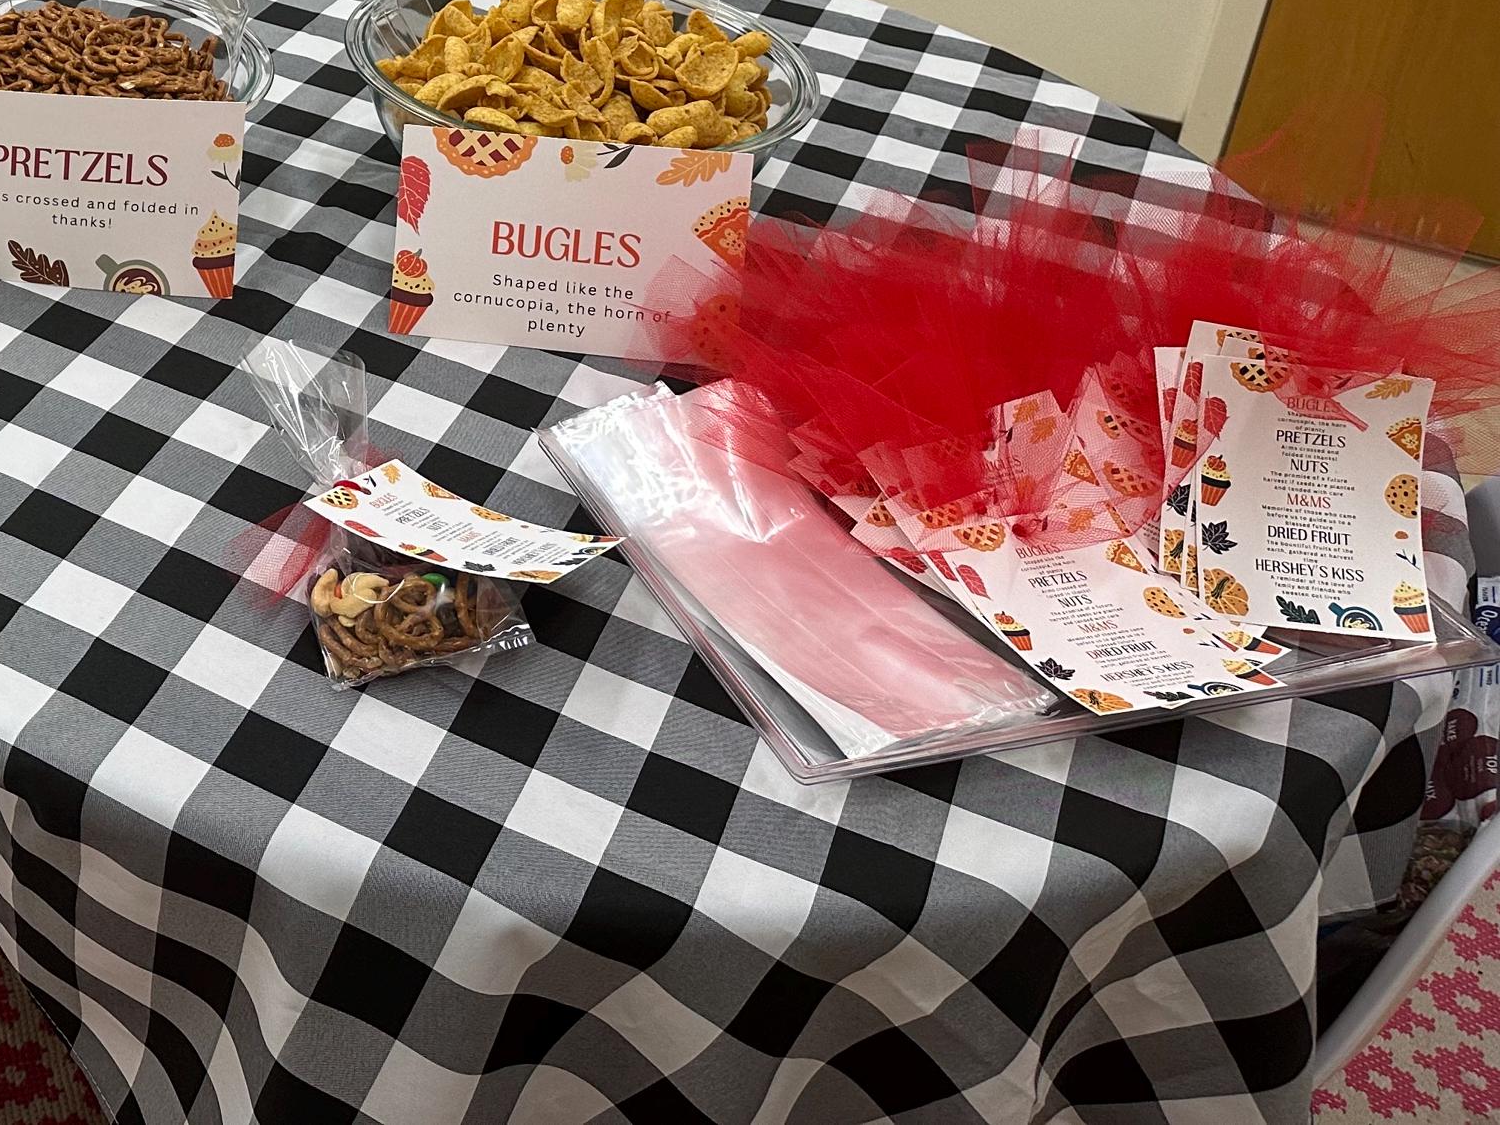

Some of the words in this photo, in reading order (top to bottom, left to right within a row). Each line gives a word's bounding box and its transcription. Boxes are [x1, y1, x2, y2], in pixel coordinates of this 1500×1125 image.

[16, 191, 80, 209] crossed
[87, 198, 117, 211] and
[123, 200, 178, 215] folded
[184, 203, 199, 215] in
[51, 213, 113, 229] thanks!
[491, 220, 642, 269] BUGLES
[492, 273, 558, 294] Shaped
[565, 280, 598, 297] like
[604, 285, 634, 300] the
[452, 290, 560, 315] cornucopia,
[568, 301, 596, 317] the
[604, 305, 645, 322] horn
[652, 311, 672, 324] of
[527, 317, 586, 338] plenty
[1276, 429, 1347, 448] PRETZELS
[1290, 459, 1329, 474] NUTS
[1286, 494, 1332, 509] M&MS
[1267, 525, 1308, 542] DRIED
[1311, 530, 1351, 546] FRUIT
[1255, 558, 1328, 579] HERSHEY'S
[1331, 566, 1365, 583] KISS
[1485, 755, 1498, 774] TOP
